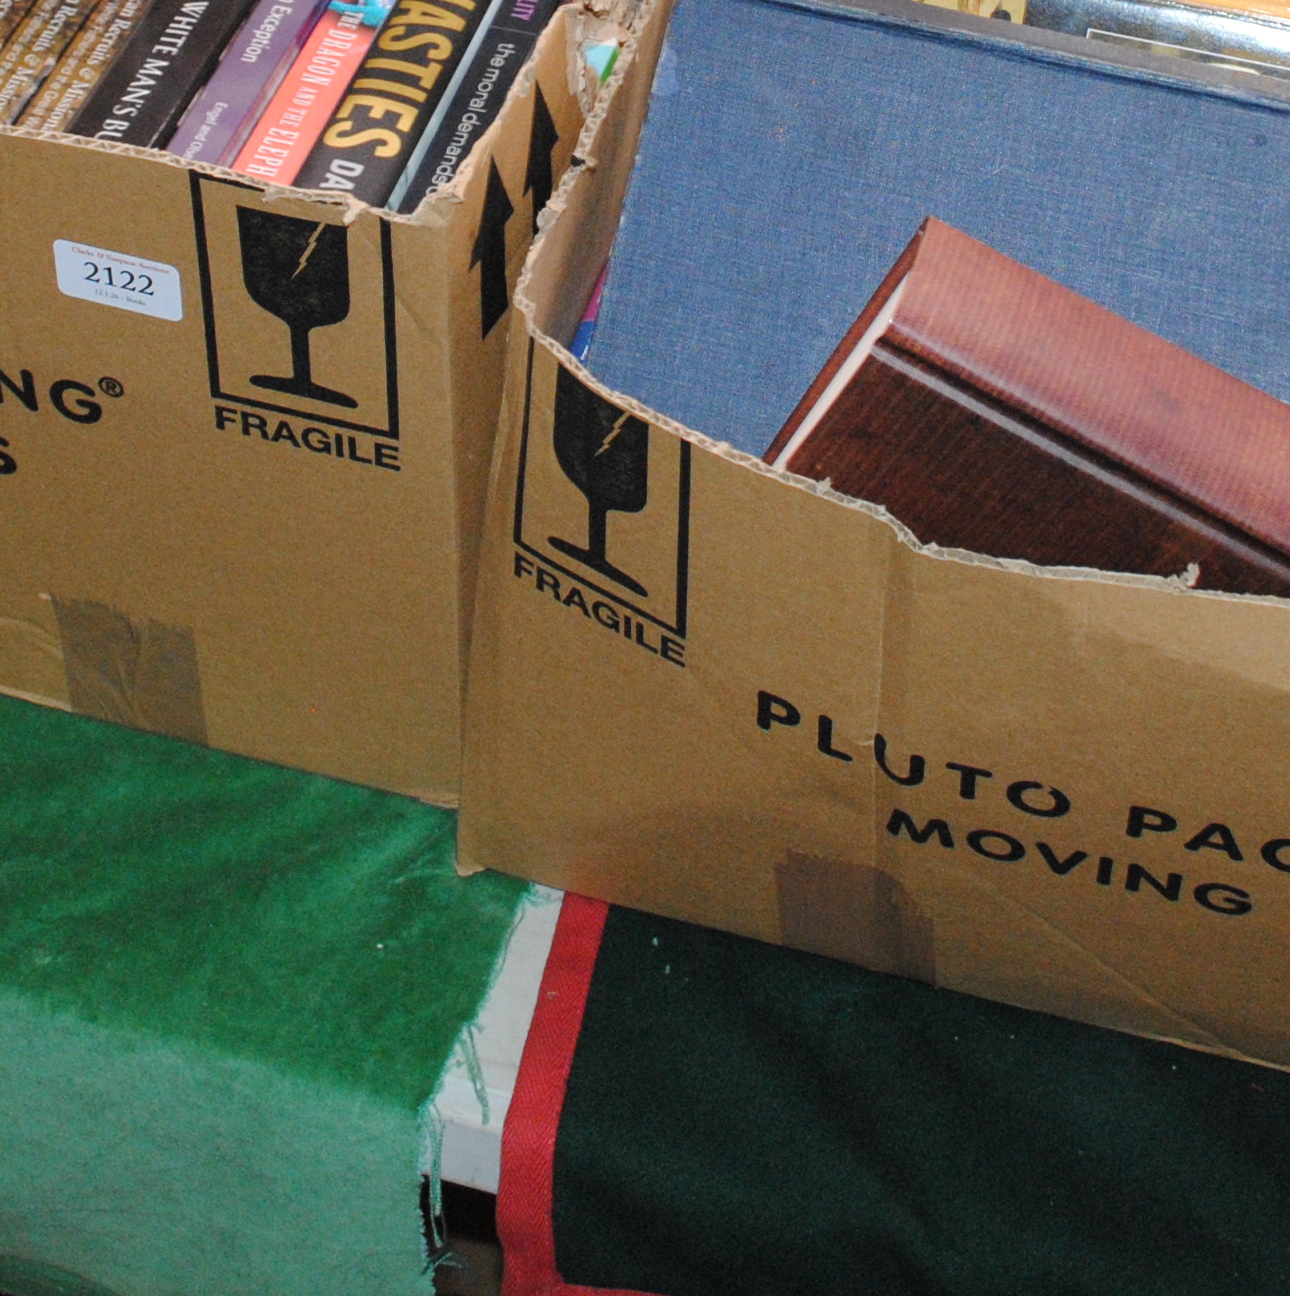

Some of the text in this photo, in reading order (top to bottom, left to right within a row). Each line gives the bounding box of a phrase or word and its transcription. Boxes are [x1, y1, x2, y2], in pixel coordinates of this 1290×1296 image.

[31, 4, 78, 53] Recruits
[85, 17, 133, 67] Recruits
[150, 0, 210, 57] WHITE
[239, 4, 294, 64] Exception
[487, 39, 518, 70] the
[110, 56, 171, 118] MAN'S
[285, 10, 366, 129] THE DRAGON AND THE
[463, 65, 507, 116] moral
[31, 88, 59, 116] Great
[193, 100, 230, 142] Engel and
[427, 110, 485, 187] demands
[82, 260, 156, 298] 2122
[213, 403, 403, 472] FRAGILE
[511, 550, 688, 669] FRAGILE
[755, 689, 1073, 819] PLUTO
[885, 807, 1254, 917] MOVING
